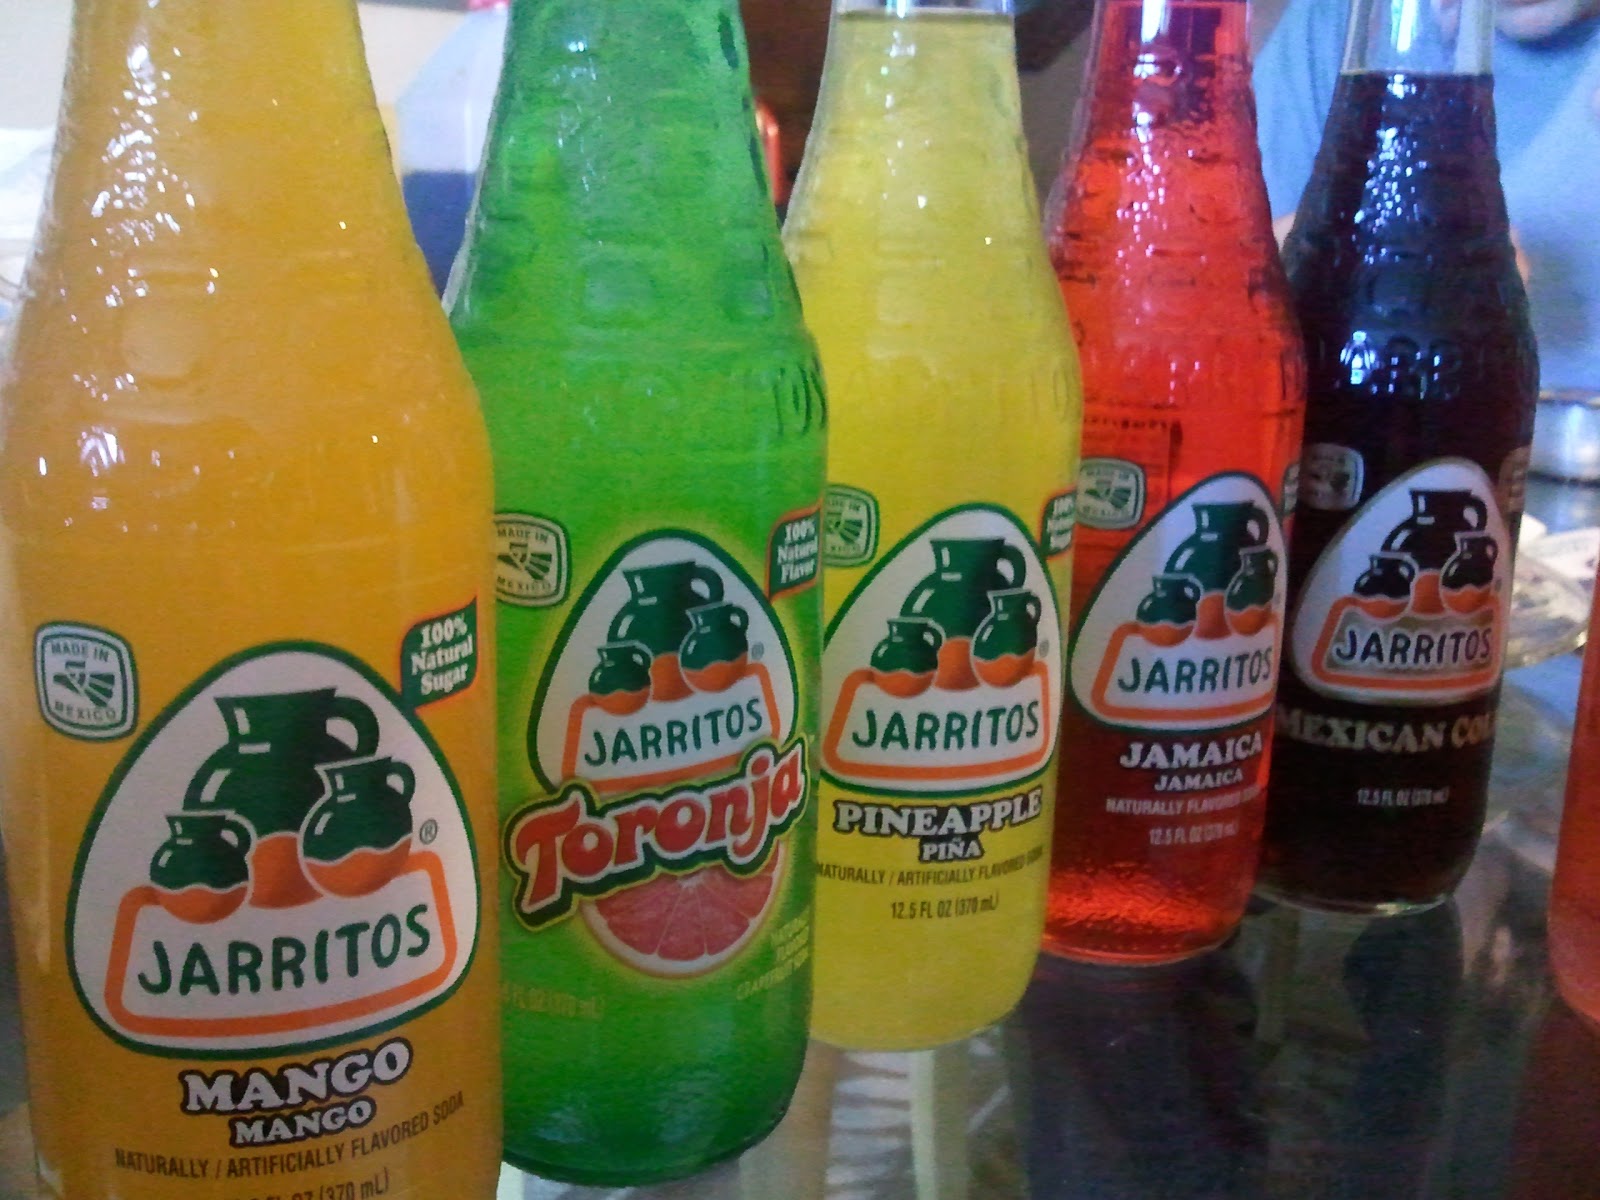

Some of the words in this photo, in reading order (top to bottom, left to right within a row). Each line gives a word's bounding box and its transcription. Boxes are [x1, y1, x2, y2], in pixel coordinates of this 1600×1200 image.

[420, 612, 468, 649] 100%
[1334, 626, 1493, 666] JARRITOS
[50, 641, 88, 656] MADE
[94, 646, 110, 662] IN
[410, 633, 474, 676] Natural
[1117, 646, 1273, 695] JARRITOS
[420, 663, 469, 696] Sugar
[54, 700, 117, 721] MEXICO
[852, 700, 1039, 751] JARRITOS
[1277, 703, 1447, 753] MEXICAN
[584, 698, 763, 766] JARRITOS
[1119, 731, 1264, 769] JAMAICA
[1154, 767, 1245, 792] JAMAICA
[835, 786, 1042, 836] PINEAPPLE
[1105, 797, 1185, 816] NATURALLY
[510, 743, 804, 916] Toronja
[921, 836, 984, 861] PIÑA
[817, 863, 886, 885] NATURALLY
[896, 867, 975, 886] ARTIFICIALLY
[890, 901, 917, 920] 12.5
[919, 901, 933, 919] FL
[936, 899, 952, 918] OZ
[137, 903, 431, 996] JARRITOS
[181, 1039, 412, 1113] MANGO
[115, 1147, 208, 1178] NATURALLY
[226, 1142, 345, 1178] ARTIFICIALLY
[350, 1111, 430, 1155] FLAVORED
[432, 1091, 465, 1127] SODA
[233, 1099, 375, 1147] MANGO
[360, 1166, 390, 1198] mL)
